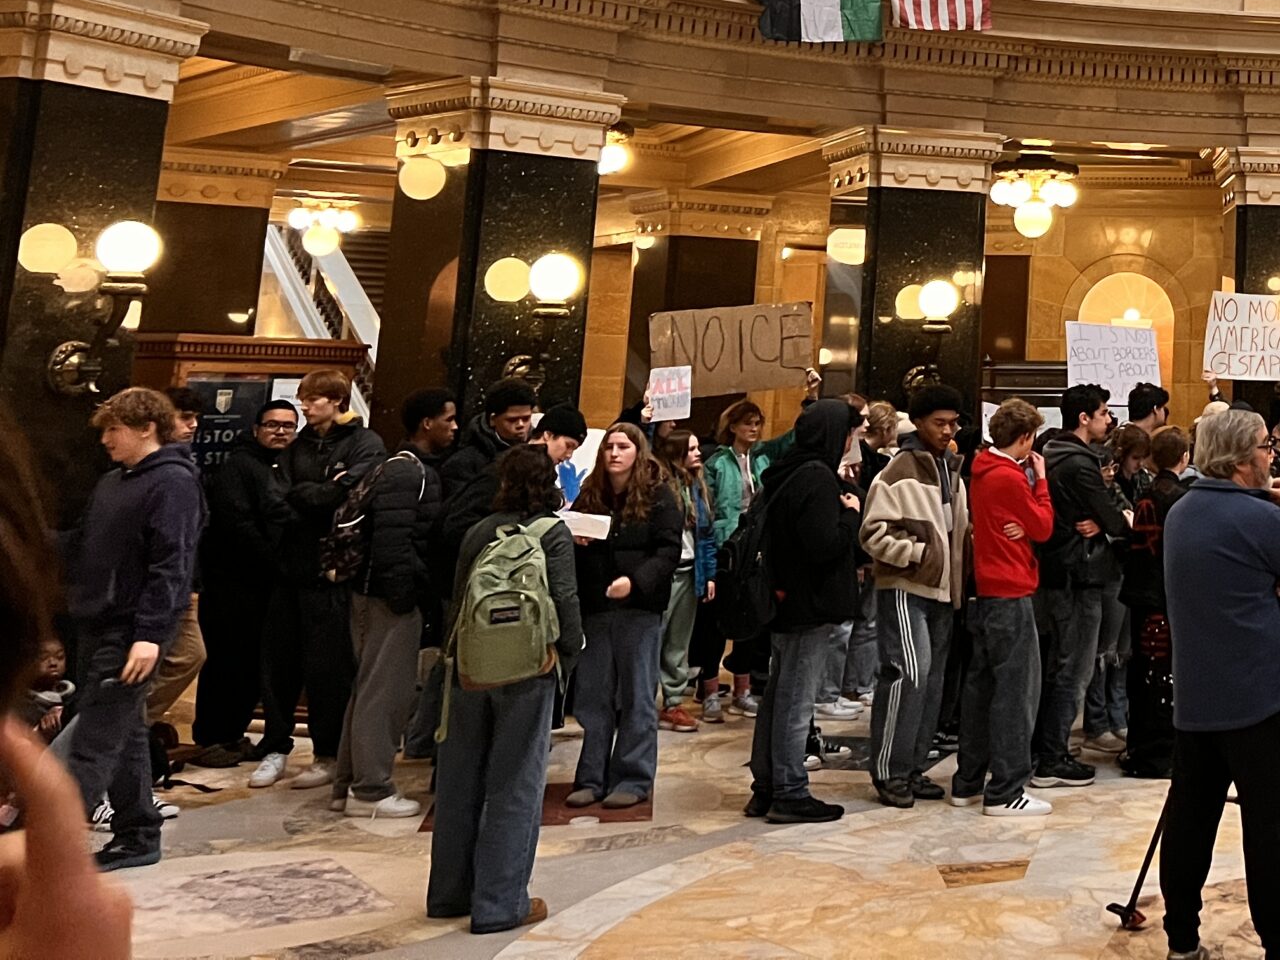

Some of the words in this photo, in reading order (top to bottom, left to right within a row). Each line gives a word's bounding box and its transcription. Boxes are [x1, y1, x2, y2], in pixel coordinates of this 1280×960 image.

[1213, 298, 1238, 322] NO
[1070, 346, 1110, 362] ABOUT
[1112, 346, 1157, 362] BORDERS
[1119, 362, 1156, 378] ABOUT
